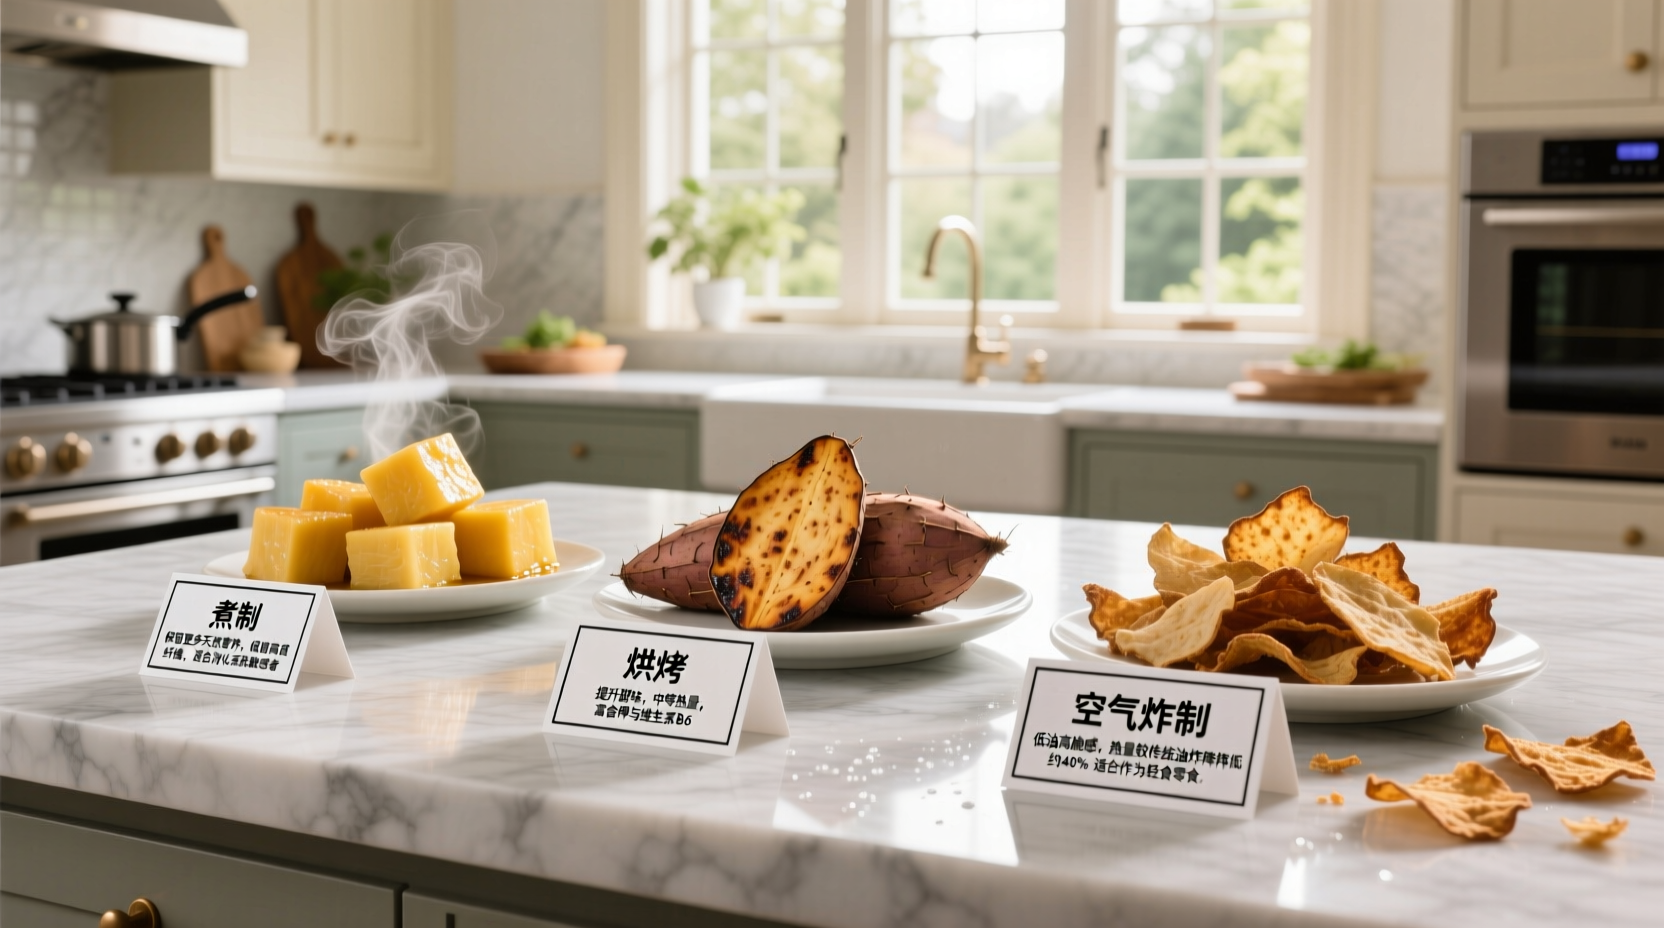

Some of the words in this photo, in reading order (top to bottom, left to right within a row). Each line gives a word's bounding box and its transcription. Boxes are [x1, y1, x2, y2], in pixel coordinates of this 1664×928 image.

[209, 600, 263, 631] 煮制
[623, 647, 689, 684] 烘烤
[1072, 691, 1211, 738] 空气炸制
